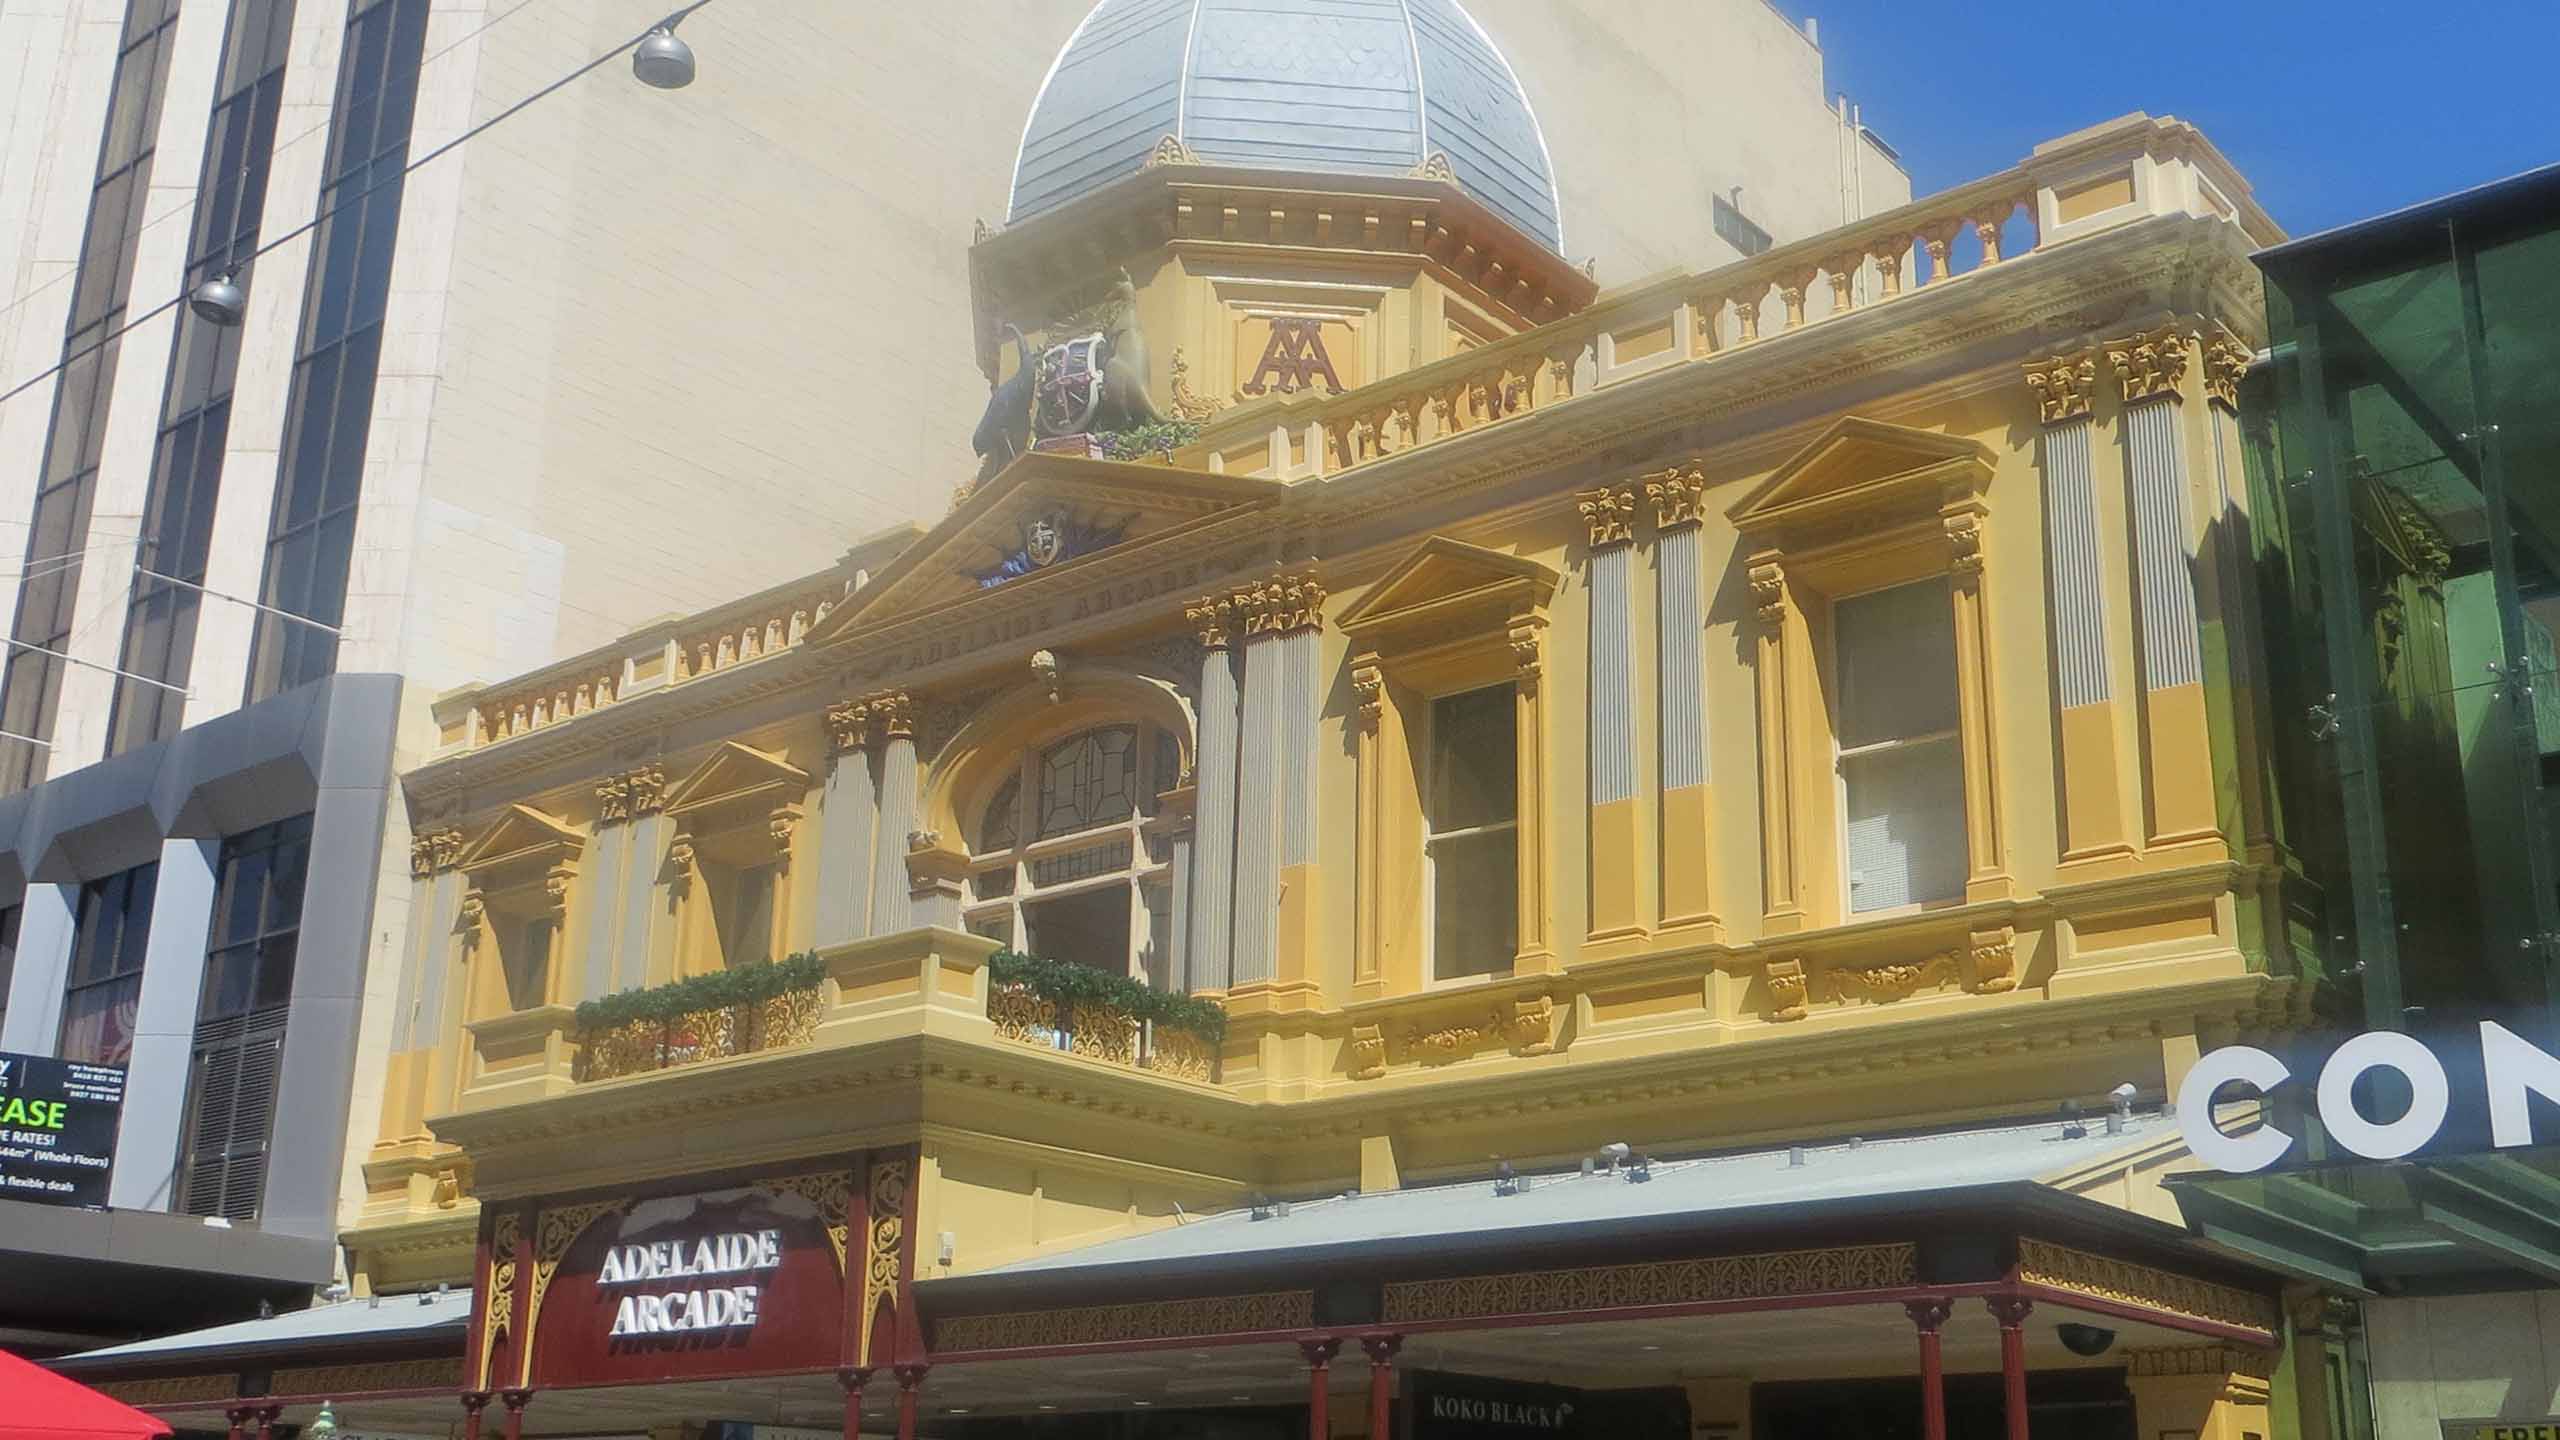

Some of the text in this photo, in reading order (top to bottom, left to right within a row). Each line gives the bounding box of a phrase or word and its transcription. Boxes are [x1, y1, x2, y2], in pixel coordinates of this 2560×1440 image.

[12, 1131, 56, 1146] RATES!
[34, 1150, 72, 1163] (Whole
[73, 1153, 109, 1169] Floors)
[8, 1176, 46, 1190] flexible
[47, 1180, 75, 1193] deals
[596, 1230, 781, 1284] ADELAIDE
[608, 1286, 759, 1336] ARCADE
[1433, 1395, 1551, 1427] KOKO BLACK
